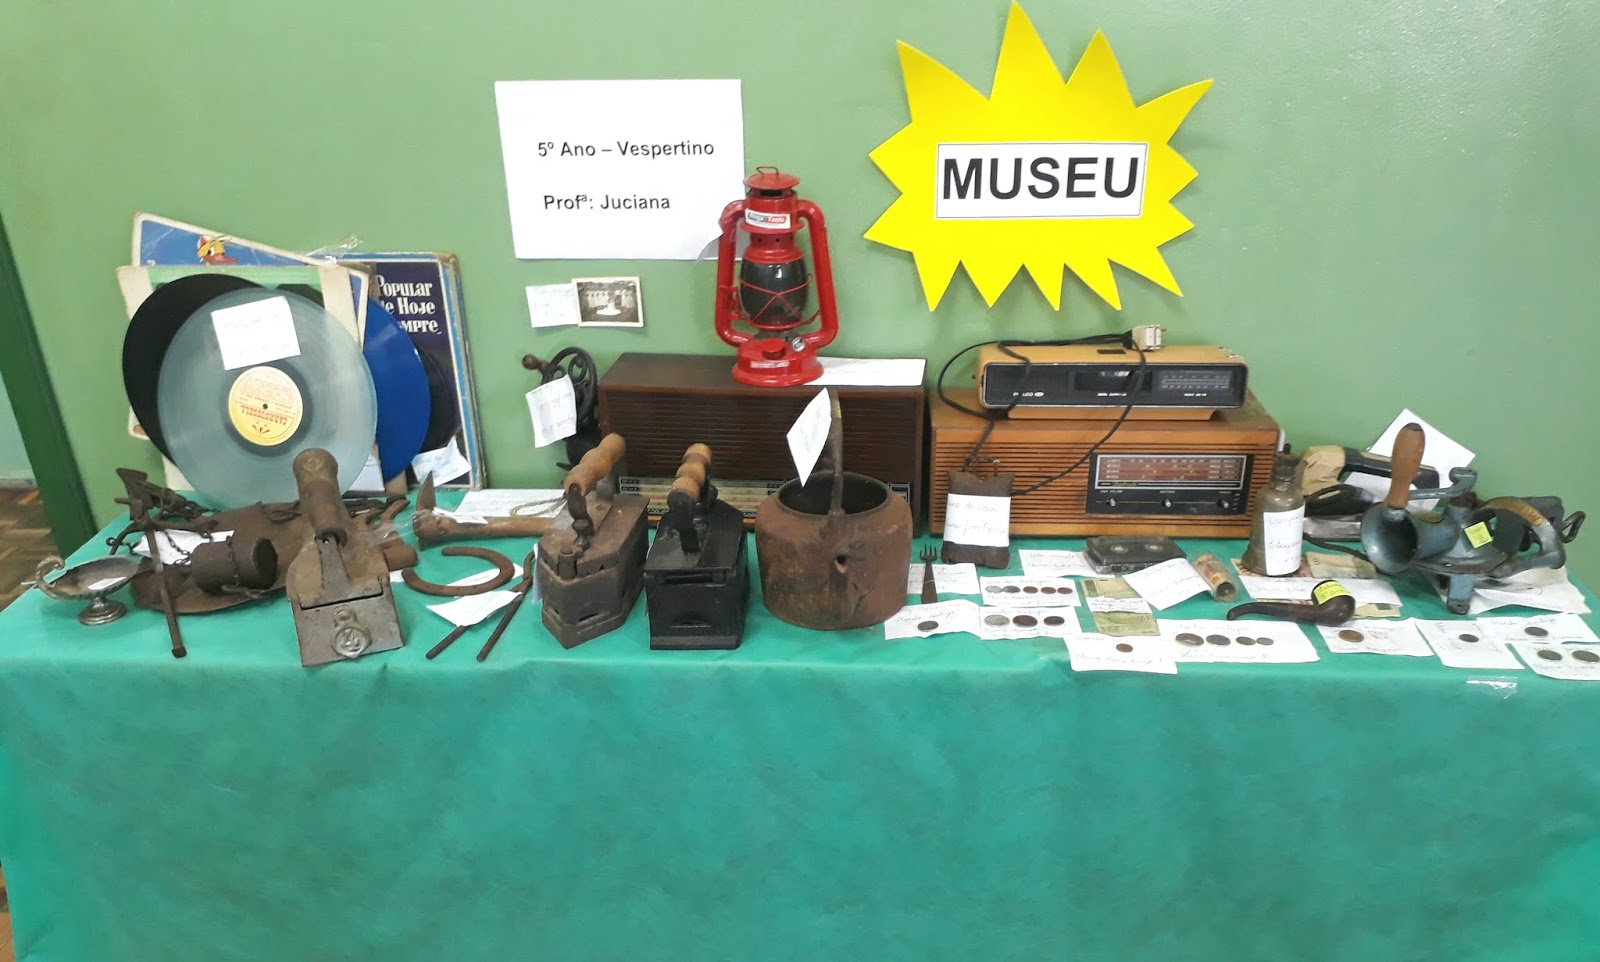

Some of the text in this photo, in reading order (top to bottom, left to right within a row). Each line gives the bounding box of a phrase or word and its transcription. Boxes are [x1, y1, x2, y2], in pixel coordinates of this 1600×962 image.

[560, 141, 596, 157] Ano
[616, 140, 715, 160] Vespertino
[943, 156, 1139, 200] MUSEU
[600, 194, 670, 210] Juciana
